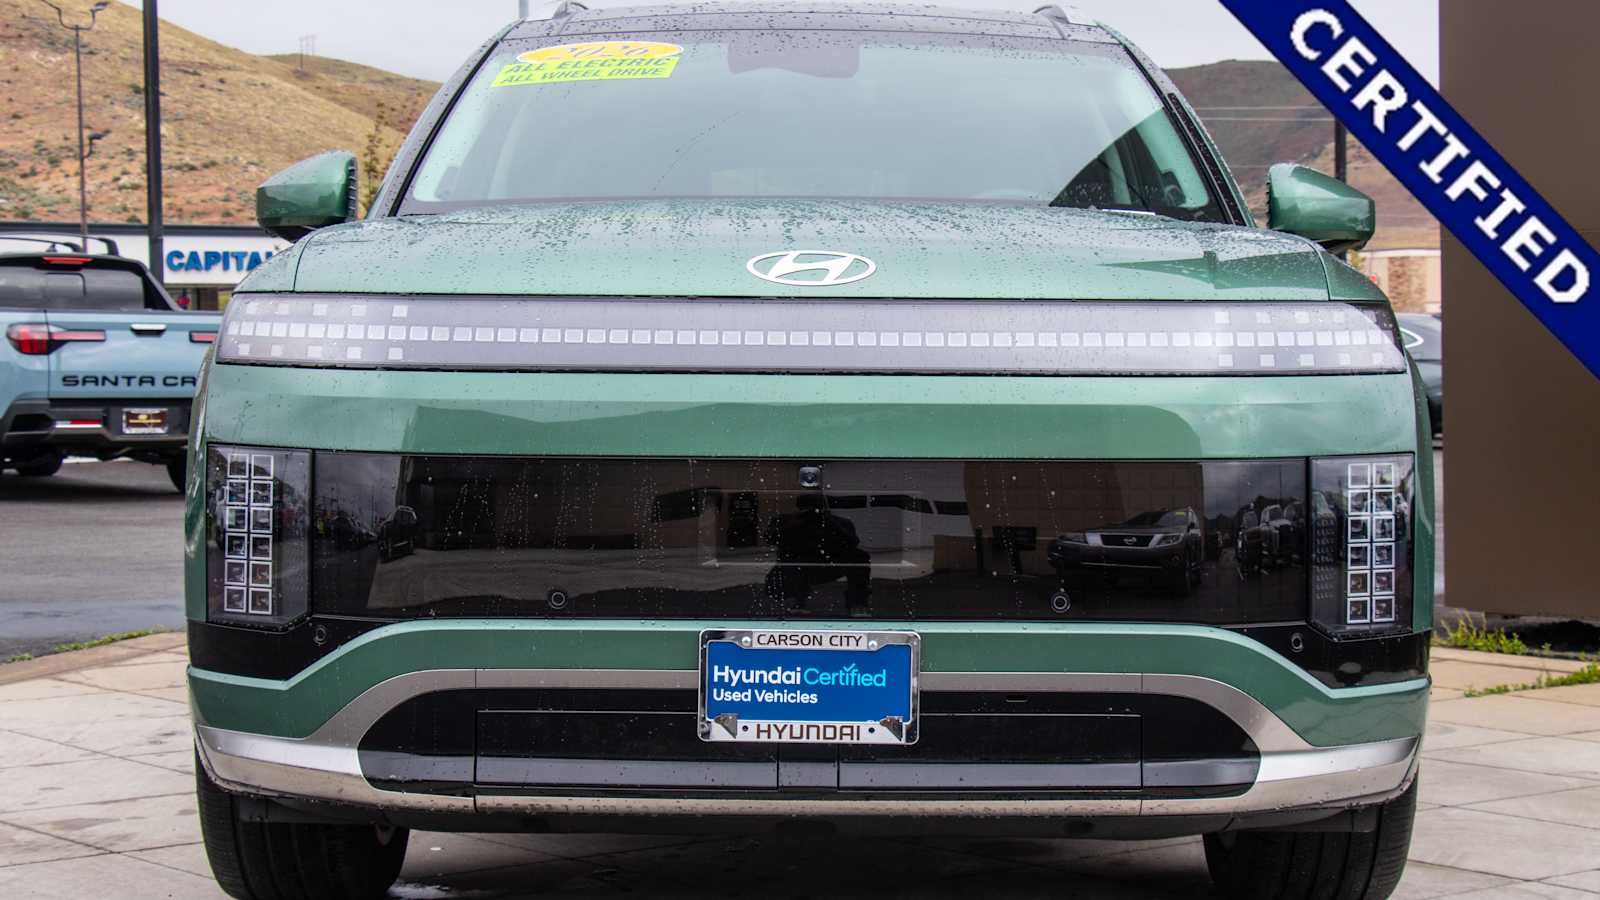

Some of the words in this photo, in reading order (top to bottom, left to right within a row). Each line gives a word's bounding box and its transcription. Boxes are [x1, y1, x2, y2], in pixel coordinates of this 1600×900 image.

[507, 63, 545, 74] ALL
[557, 57, 671, 69] ELECTRIC
[501, 74, 533, 84] ALL
[541, 69, 601, 79] WHEEL
[608, 67, 666, 76] DRIVE
[61, 375, 155, 387] SANTA
[757, 634, 823, 646] CARSON
[829, 635, 863, 647] CITY
[713, 665, 801, 687] Hyundai
[803, 664, 887, 687] Certified
[713, 688, 751, 702] Used
[754, 689, 818, 704] Vehicles
[756, 724, 860, 741] HYUNDAI
